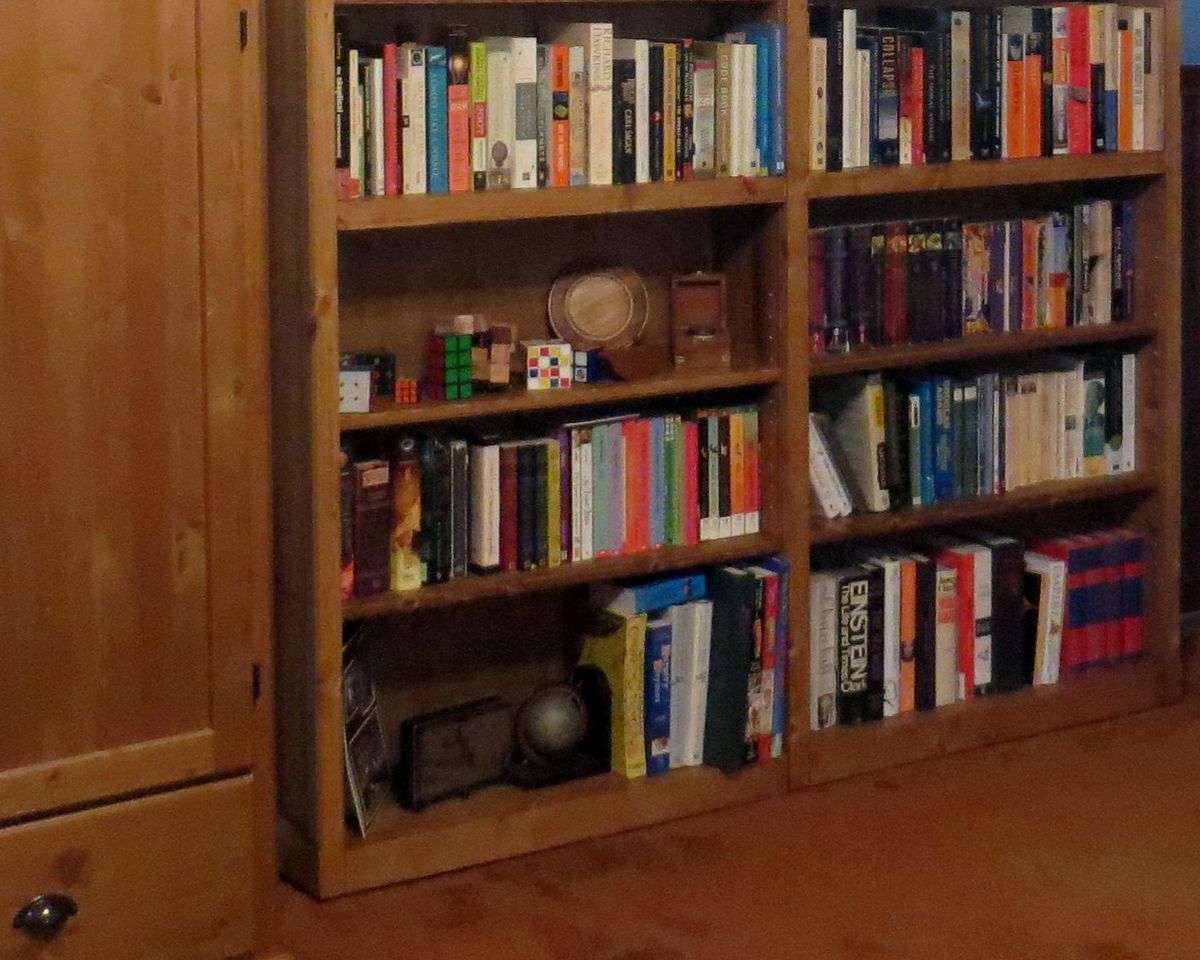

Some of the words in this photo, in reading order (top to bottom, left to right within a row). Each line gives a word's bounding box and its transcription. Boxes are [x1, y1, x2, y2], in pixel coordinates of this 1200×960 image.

[602, 27, 612, 81] RICHARD
[624, 109, 633, 128] CARL
[624, 129, 633, 154] SAGAN
[849, 579, 869, 681] EINSTEIN
